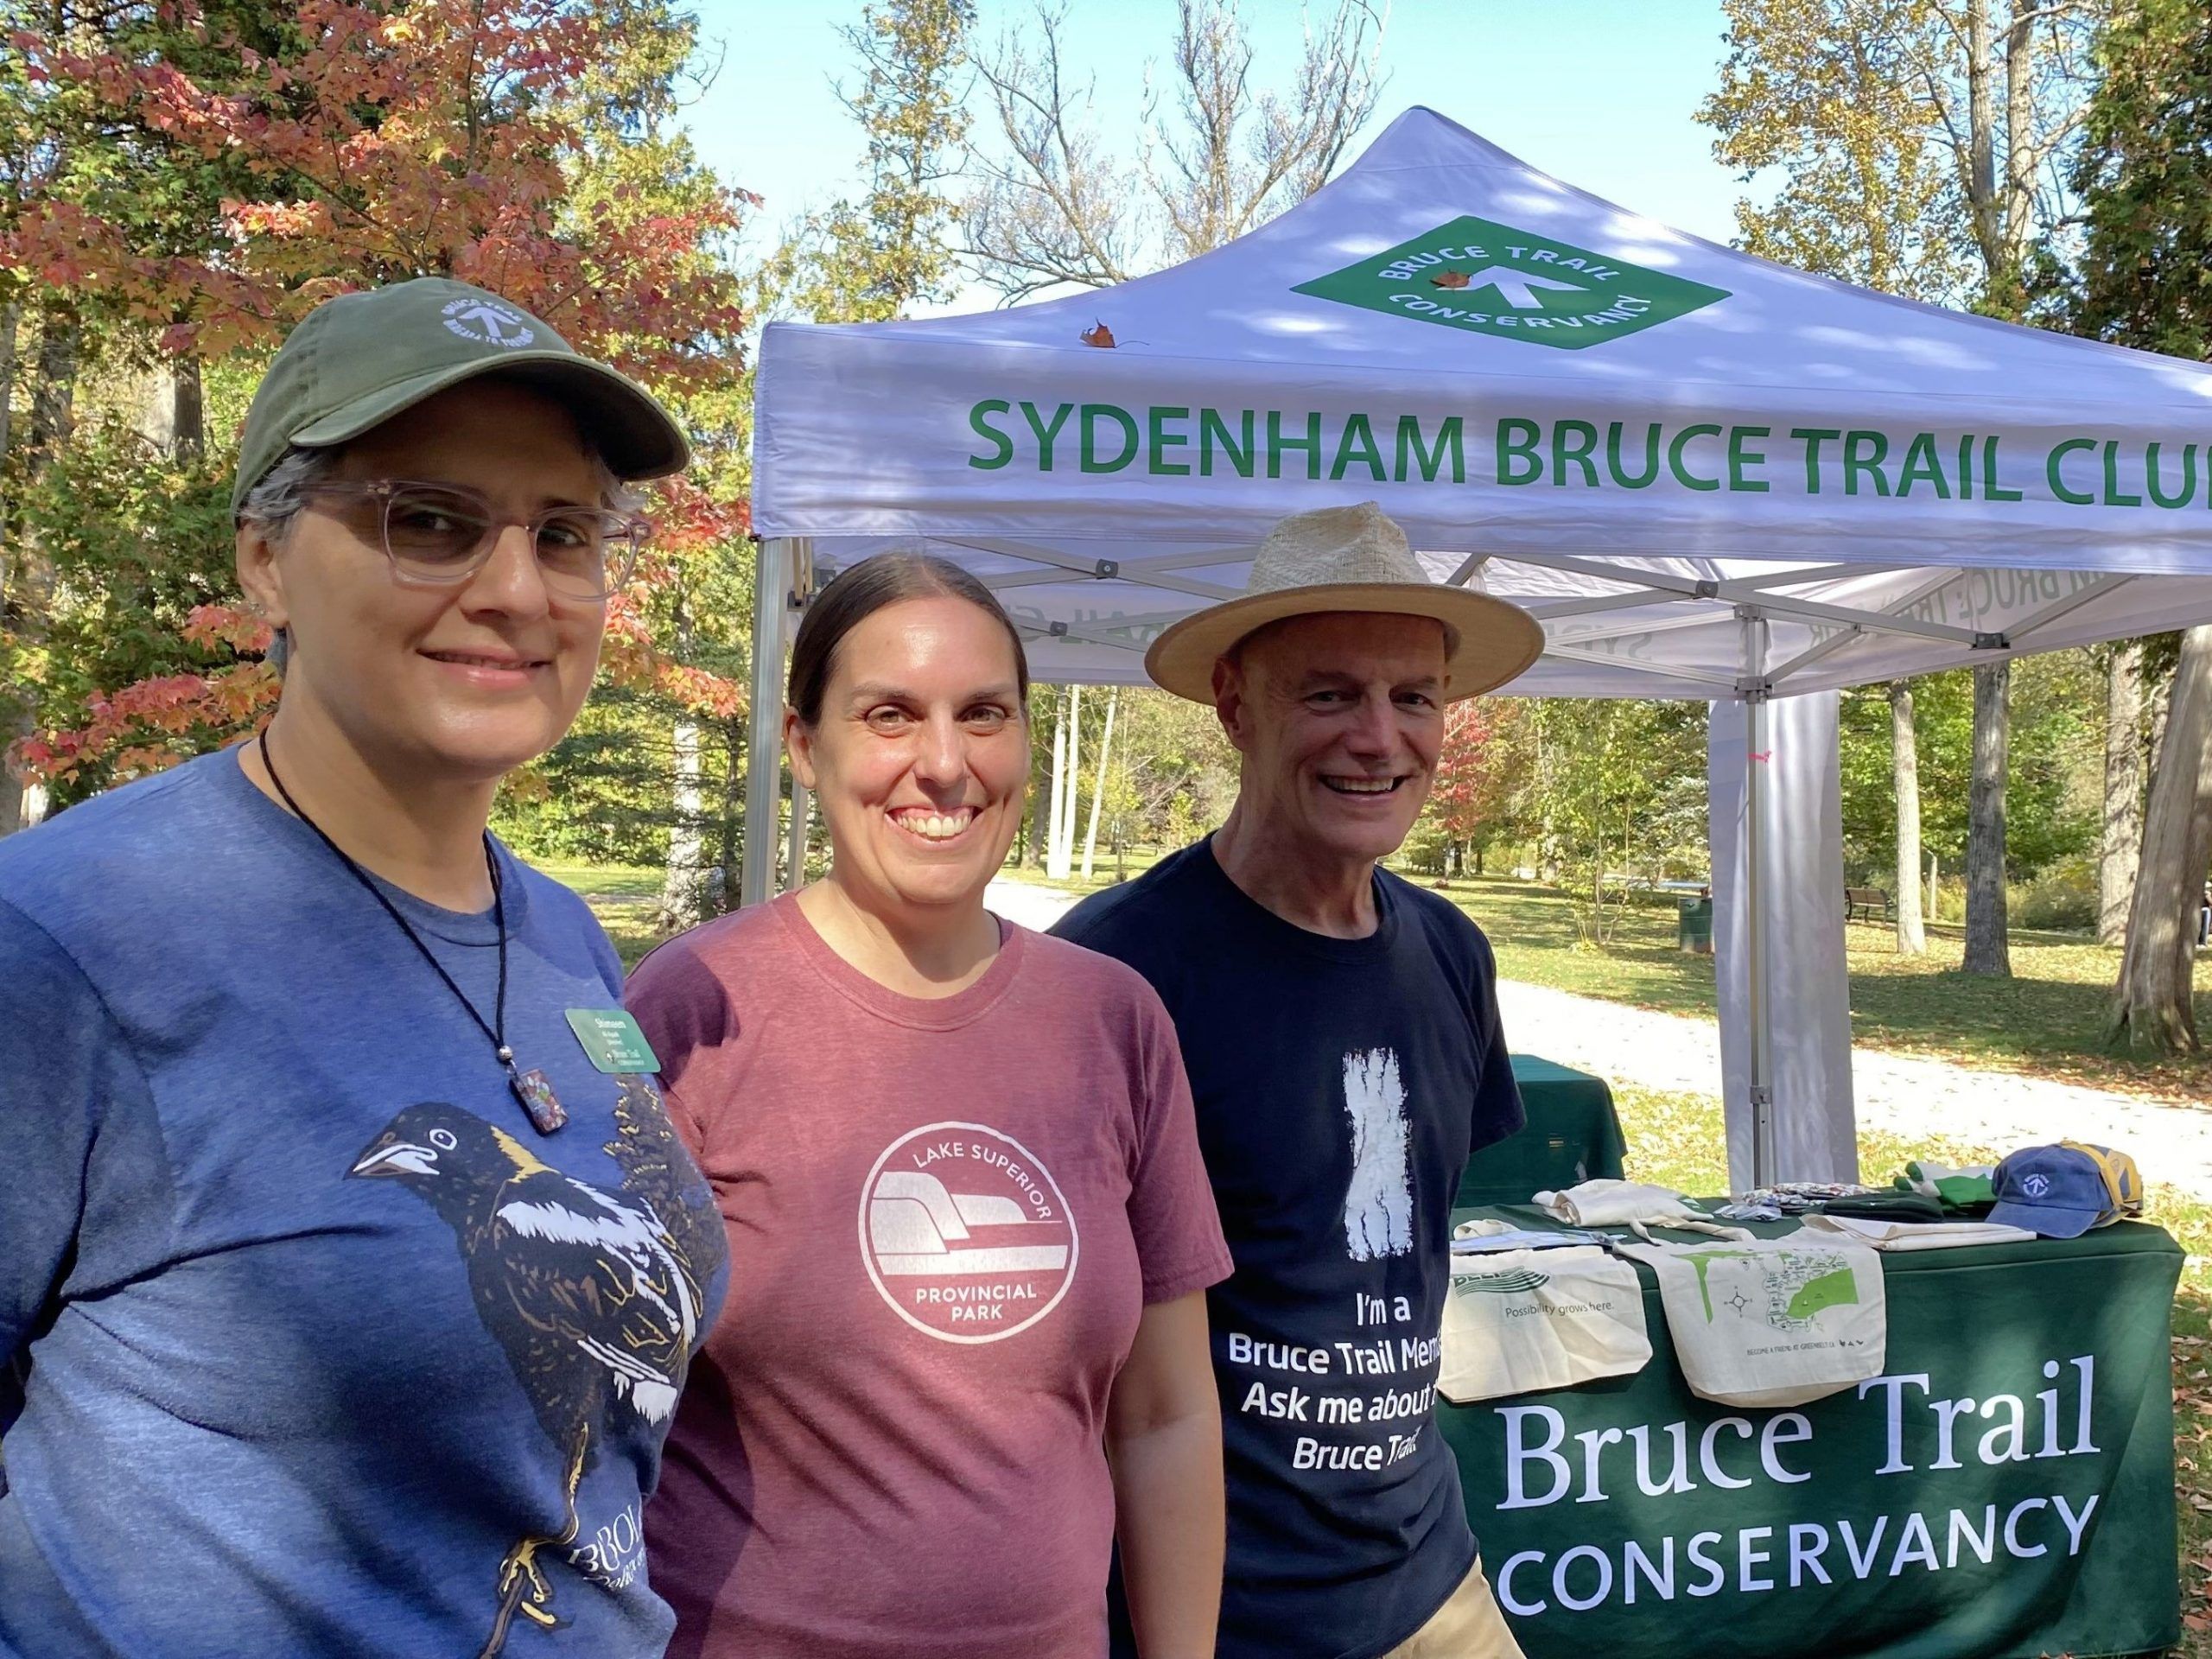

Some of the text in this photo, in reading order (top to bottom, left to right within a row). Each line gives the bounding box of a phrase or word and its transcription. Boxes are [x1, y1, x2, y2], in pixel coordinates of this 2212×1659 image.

[1378, 245, 1621, 281] BRUCE TRAIL
[1389, 292, 1652, 329] CONSERVANCY
[968, 399, 2212, 510] SYDENHAM BRUCE TRAIL CLU
[912, 1141, 1053, 1219] LAKE SUPERIOR
[916, 1283, 1038, 1304] PROVINCIAL
[1356, 1292, 1412, 1325] I'm a
[1505, 1304, 1556, 1319] Possibility
[1558, 1304, 1588, 1317] grows
[951, 1304, 1003, 1322] PARK
[1229, 1332, 1331, 1374] Bruce
[1334, 1339, 1396, 1376] Trail
[1241, 1382, 1311, 1422] Ask
[1317, 1395, 1363, 1424] me
[1368, 1382, 1431, 1422] about
[1493, 1354, 2101, 1510] Bruce Trail
[1293, 1436, 1382, 1471] Bruce
[1497, 1494, 2101, 1617] CONSERVANCY
